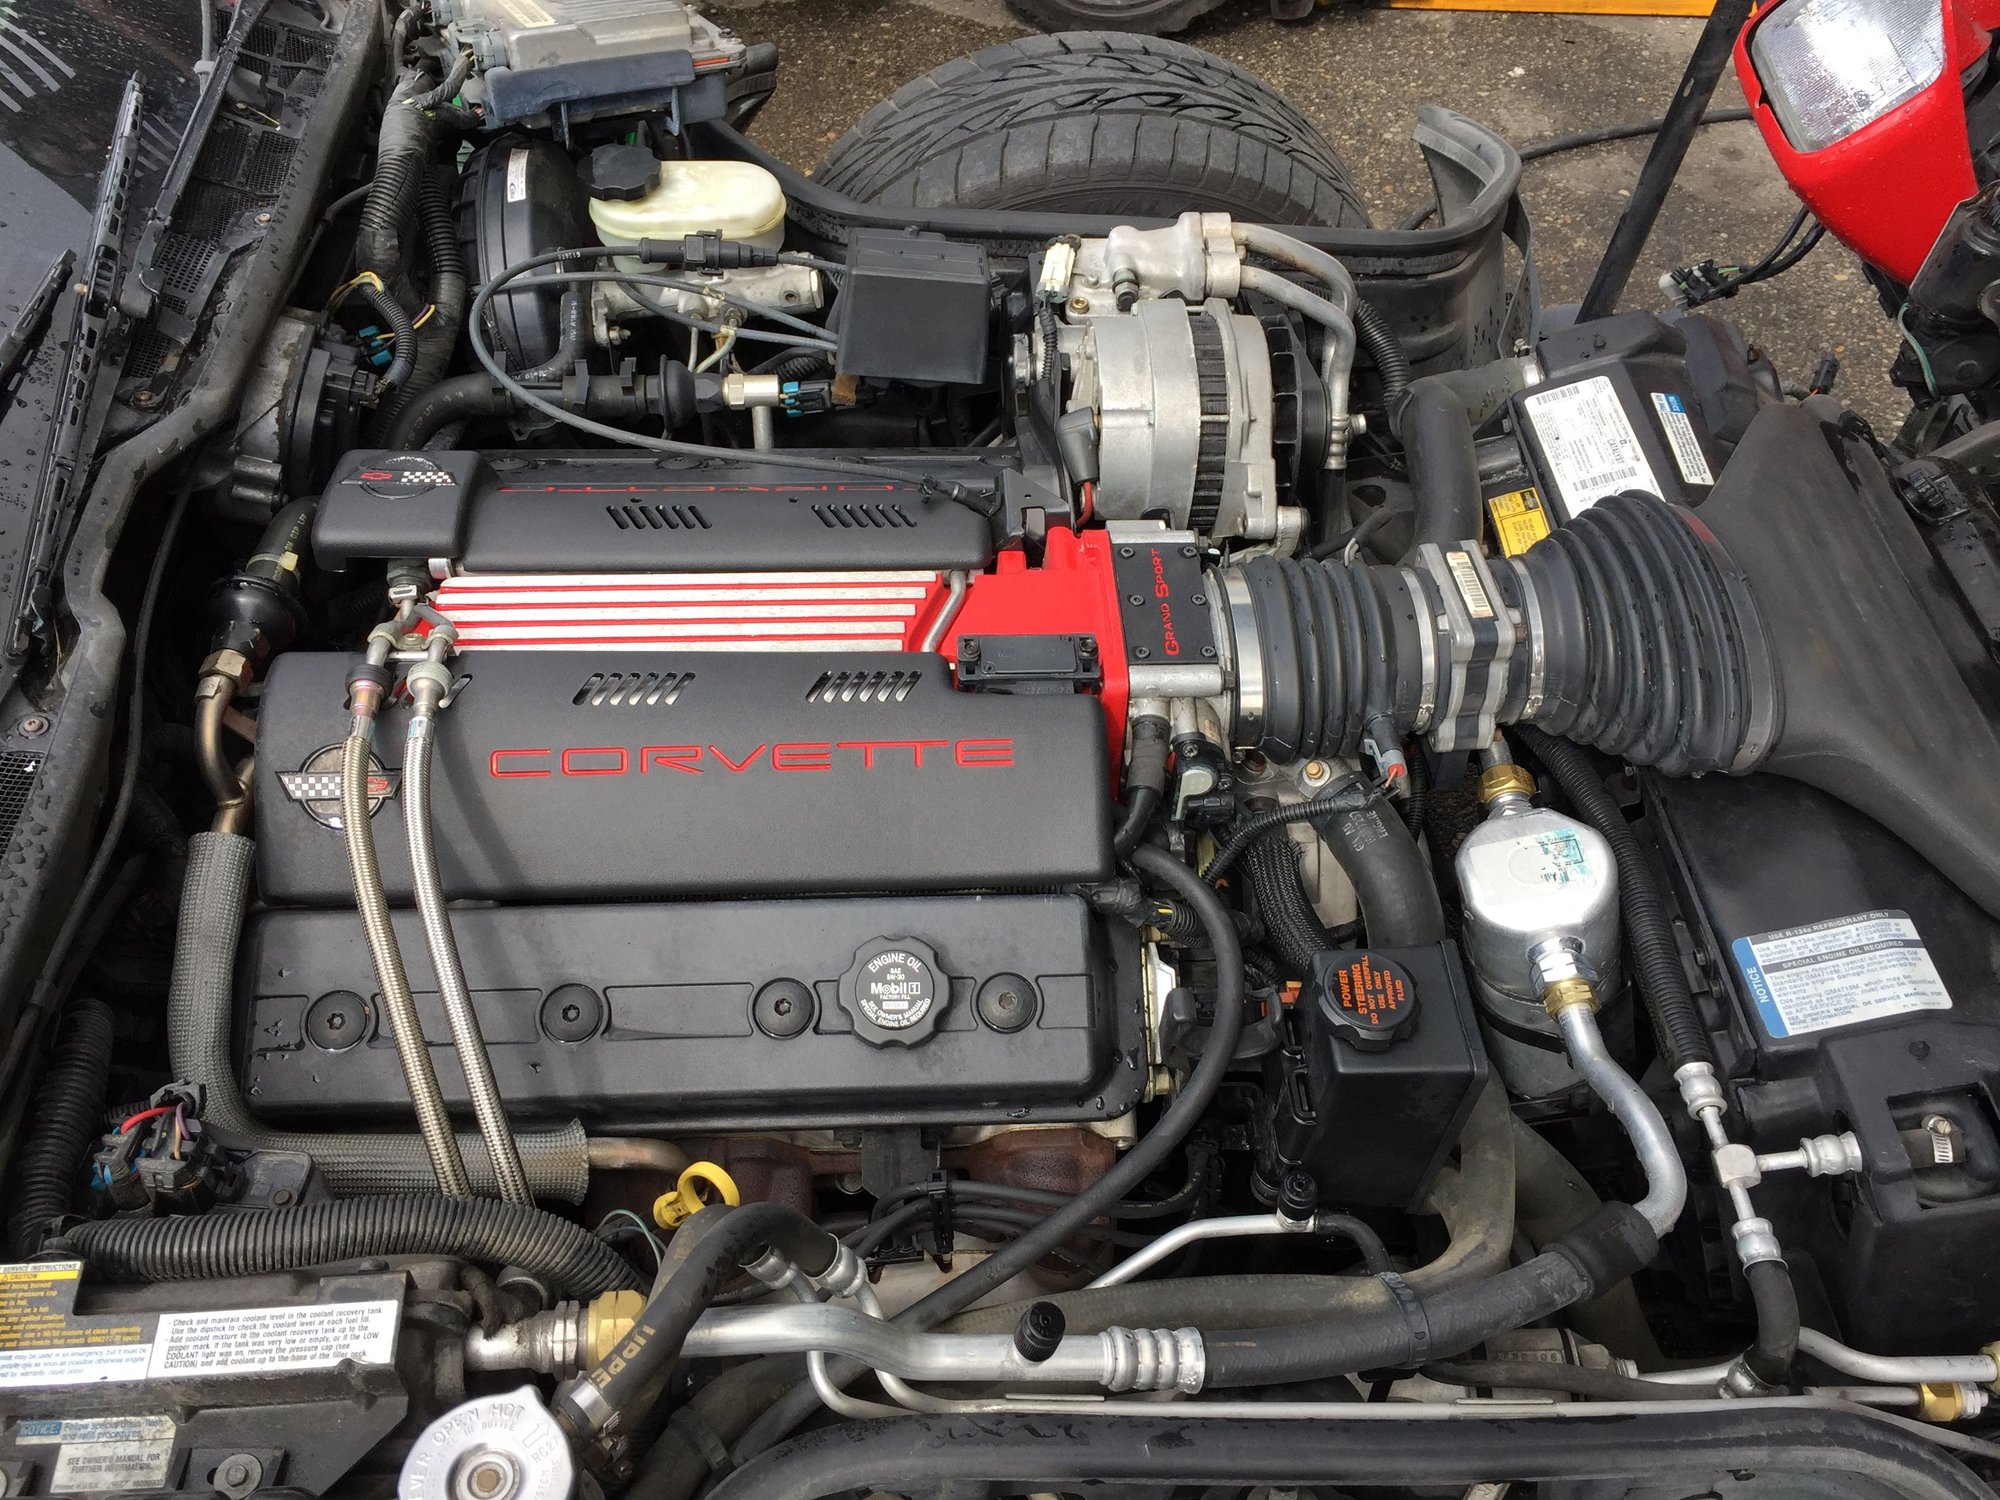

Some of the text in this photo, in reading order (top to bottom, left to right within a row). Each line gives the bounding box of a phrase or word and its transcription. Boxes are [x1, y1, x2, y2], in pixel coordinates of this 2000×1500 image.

[1607, 439, 1624, 464] CATALYST
[1151, 548, 1180, 656] GRAND SPORT
[489, 738, 1016, 778] CORVETTE
[1785, 928, 1812, 936] R-134a
[1813, 914, 1868, 930] REFRIGERANT
[868, 953, 921, 972] ENGINE OIL
[1782, 957, 1816, 968] SPECIAL
[1818, 950, 1847, 961] ENGINE
[1864, 940, 1904, 951] REQUIRED
[871, 982, 907, 994] Mobil
[1339, 969, 1352, 1008] POWER
[1351, 963, 1367, 1015] STEERING
[1361, 955, 1379, 1024] DO NOT OVERFILL
[1373, 971, 1386, 1009] USE ONLY
[1383, 970, 1396, 1010] APPROVED
[1395, 980, 1405, 1001] FLUID
[1747, 966, 1769, 1003] NOTICE
[861, 999, 877, 1020] SPECIAL
[878, 1017, 899, 1027] ENGINE
[910, 998, 930, 1023] REQUIRED
[903, 1000, 923, 1018] MANUAL
[30, 1263, 77, 1271] INSTRUCTIONS
[171, 1327, 184, 1335] Use
[186, 1326, 198, 1334] the
[200, 1325, 226, 1334] dipstick
[237, 1323, 257, 1331] check
[272, 1321, 297, 1329] coolant
[299, 1319, 316, 1327] level
[345, 1316, 358, 1324] fuel
[173, 1318, 194, 1326] Check
[210, 1316, 240, 1324] maintain
[242, 1315, 267, 1323] coolant
[310, 1310, 334, 1318] coolant
[367, 1307, 382, 1315] tank
[168, 1344, 190, 1352] proper
[192, 1342, 210, 1350] mark.
[234, 1340, 249, 1348] tank
[308, 1336, 331, 1344] empty,
[363, 1332, 380, 1340] LOW
[185, 1334, 210, 1342] coolant
[212, 1332, 238, 1340] mixture
[262, 1329, 287, 1337] coolant
[290, 1328, 319, 1336] recovery
[321, 1326, 336, 1334] tank
[338, 1326, 347, 1334] up
[358, 1324, 369, 1332] the
[164, 1360, 198, 1369] CAUTION)
[216, 1358, 229, 1366] add
[230, 1356, 256, 1365] coolant
[257, 1356, 267, 1364] up
[278, 1354, 290, 1362] the
[290, 1353, 307, 1361] base
[319, 1352, 330, 1360] the
[166, 1351, 199, 1360] COOLANT
[201, 1351, 216, 1359] light
[288, 1344, 319, 1353] pressure
[320, 1343, 334, 1351] cap
[335, 1342, 350, 1350] (see
[588, 1325, 656, 1390] UPPE
[433, 1407, 480, 1446] OPEN
[488, 1402, 526, 1421] HOT
[62, 1433, 77, 1441] and
[66, 1453, 161, 1466] SEE OWNER'S MANUAL FOR
[71, 1465, 102, 1474] FURTHER
